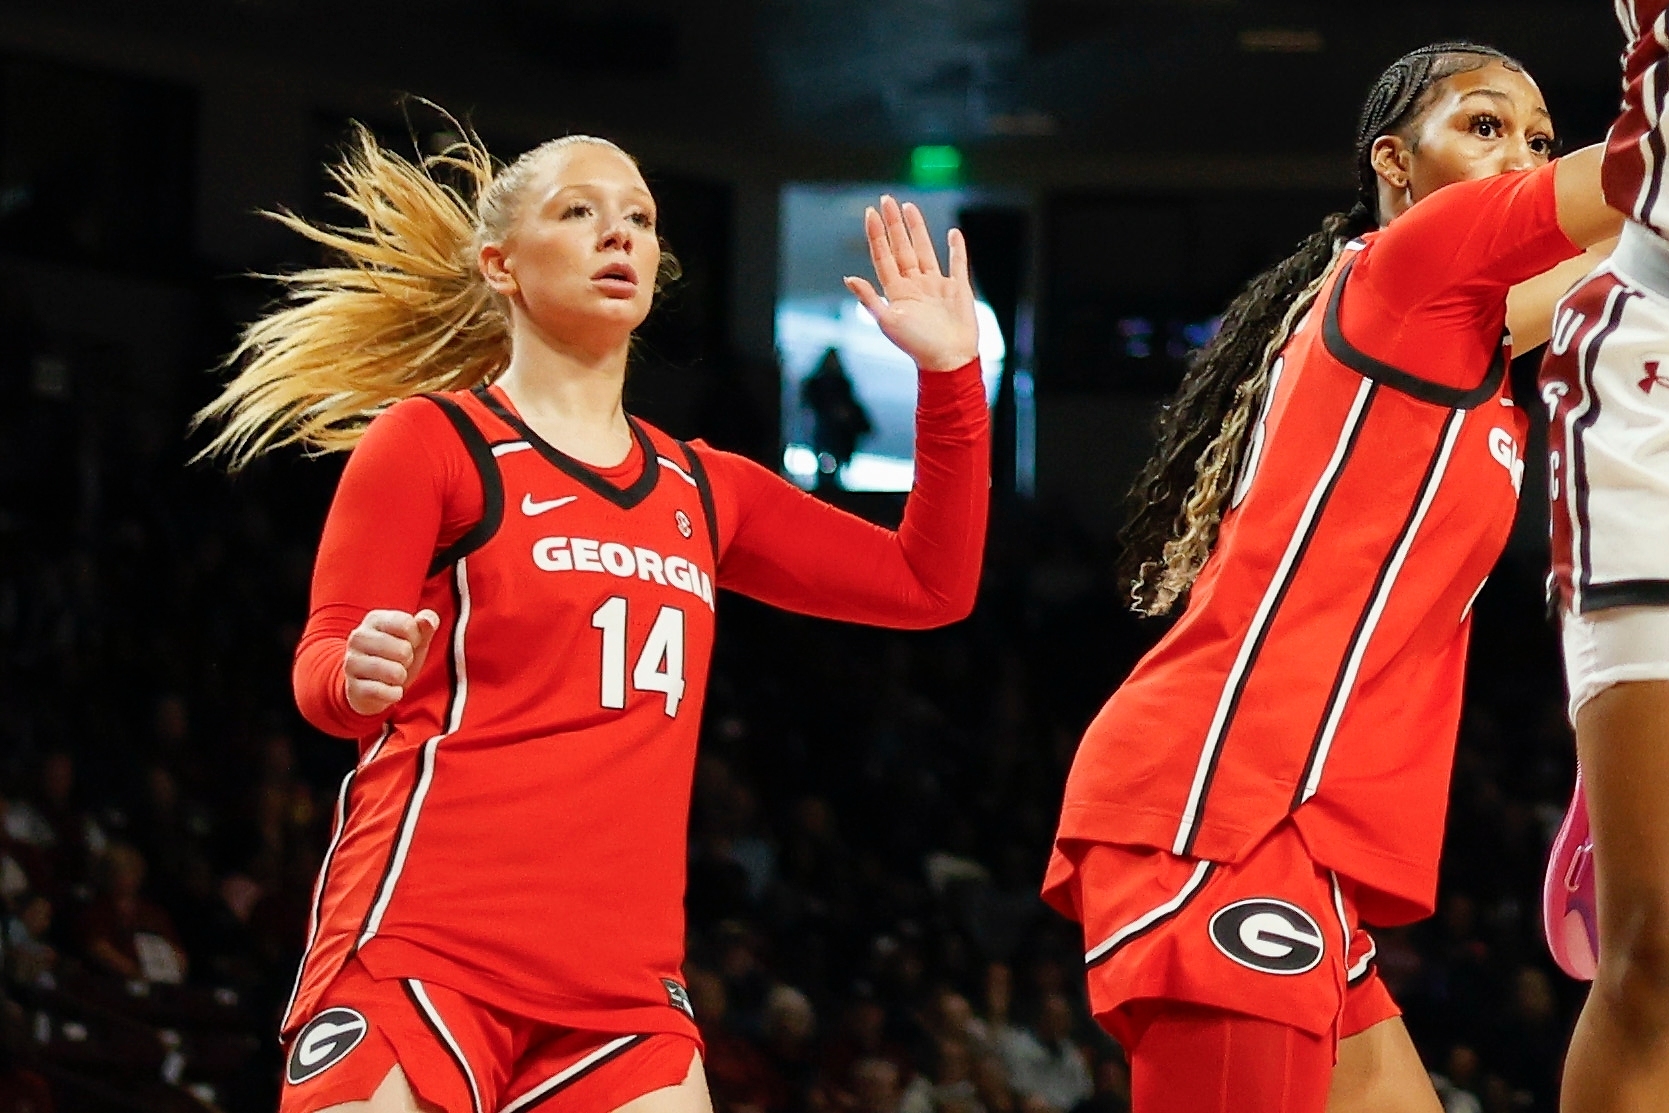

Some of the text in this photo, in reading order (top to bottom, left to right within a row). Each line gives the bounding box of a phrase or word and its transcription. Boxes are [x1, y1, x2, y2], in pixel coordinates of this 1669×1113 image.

[591, 595, 685, 718] 14
[1231, 906, 1323, 964] G
[295, 1016, 367, 1070] G
